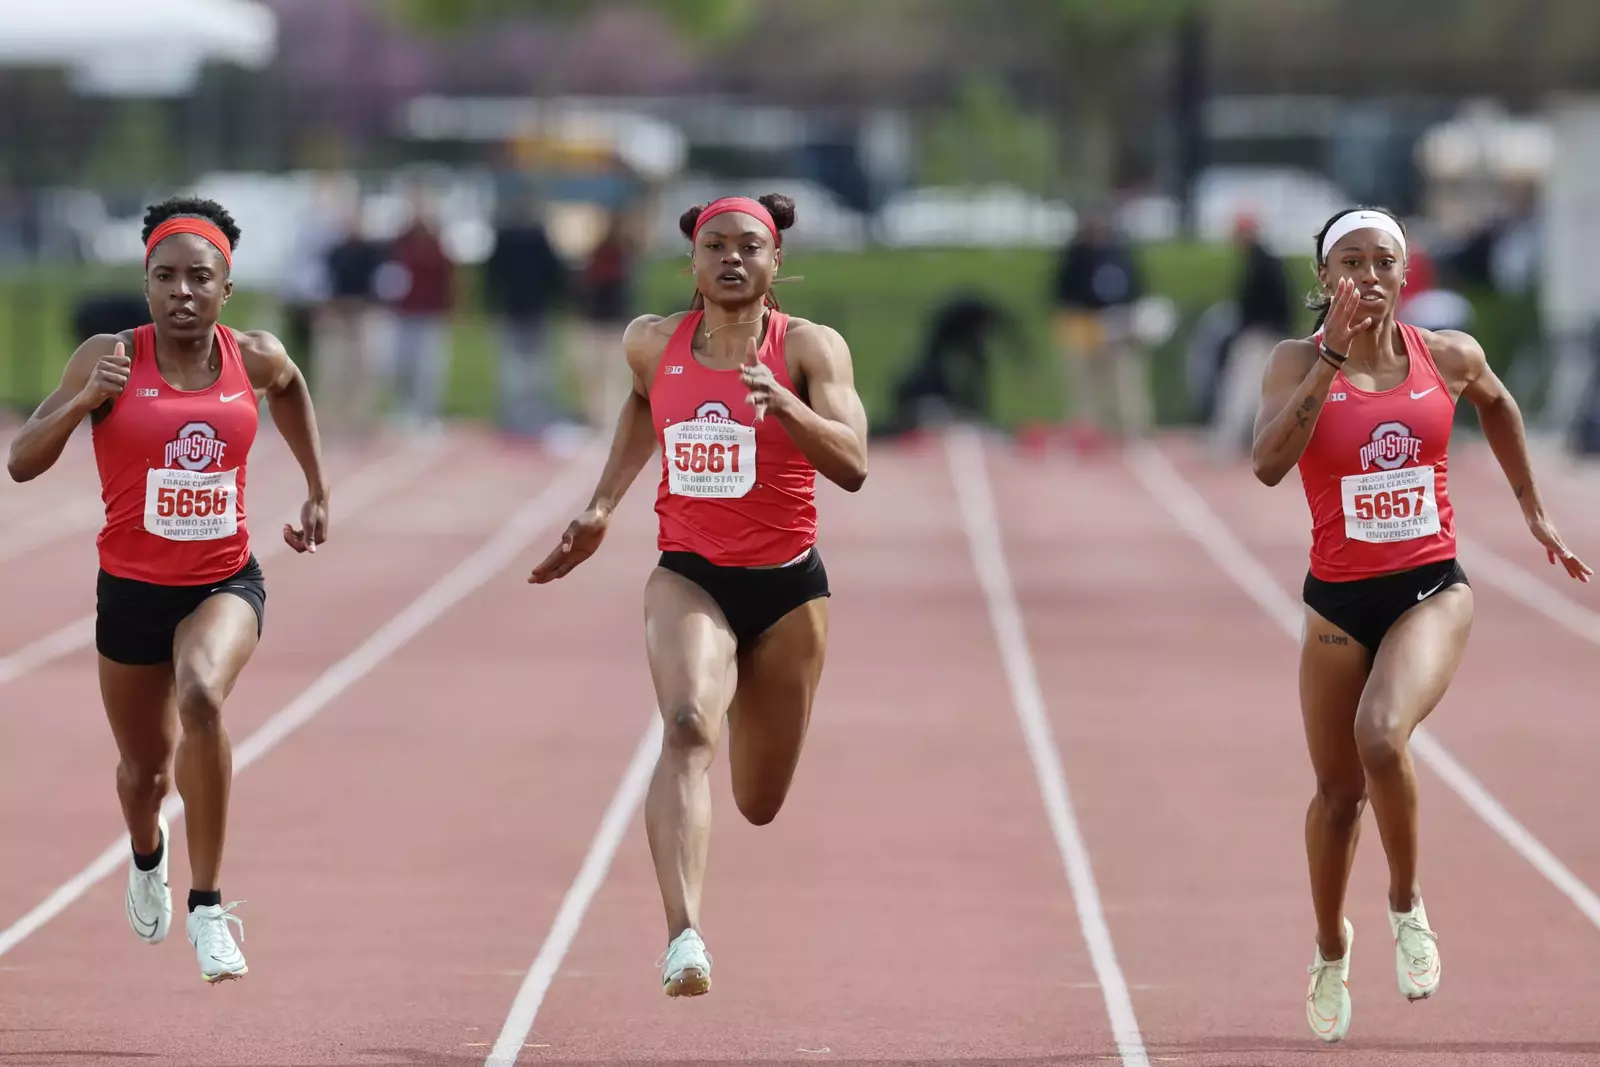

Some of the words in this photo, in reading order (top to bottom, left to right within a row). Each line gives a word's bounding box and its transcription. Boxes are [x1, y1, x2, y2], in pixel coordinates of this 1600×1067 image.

[681, 424, 703, 432] JESSE
[704, 433, 738, 441] CLASSIC
[674, 443, 740, 473] 5661
[677, 473, 689, 482] THE
[690, 475, 712, 483] OHIO
[714, 475, 745, 483] STATE
[1360, 475, 1385, 483] JESSE
[1387, 470, 1416, 480] OWENS
[162, 478, 190, 487] TRACK
[192, 479, 221, 487] CLASSIC
[1357, 483, 1385, 492] TRACK
[1387, 478, 1420, 488] CLASSIC
[682, 485, 736, 493] UNIVERSITY
[157, 486, 228, 517] 5656
[1354, 486, 1425, 520] 5657
[156, 518, 172, 527] THE
[175, 519, 197, 527] OHIO
[200, 517, 228, 527] STATE
[1356, 521, 1374, 529] THE
[1377, 521, 1399, 529] OHIO
[1401, 517, 1428, 528] STATE
[163, 527, 220, 536] UNIVERSITY
[1365, 528, 1421, 539] UNIVERSITY
